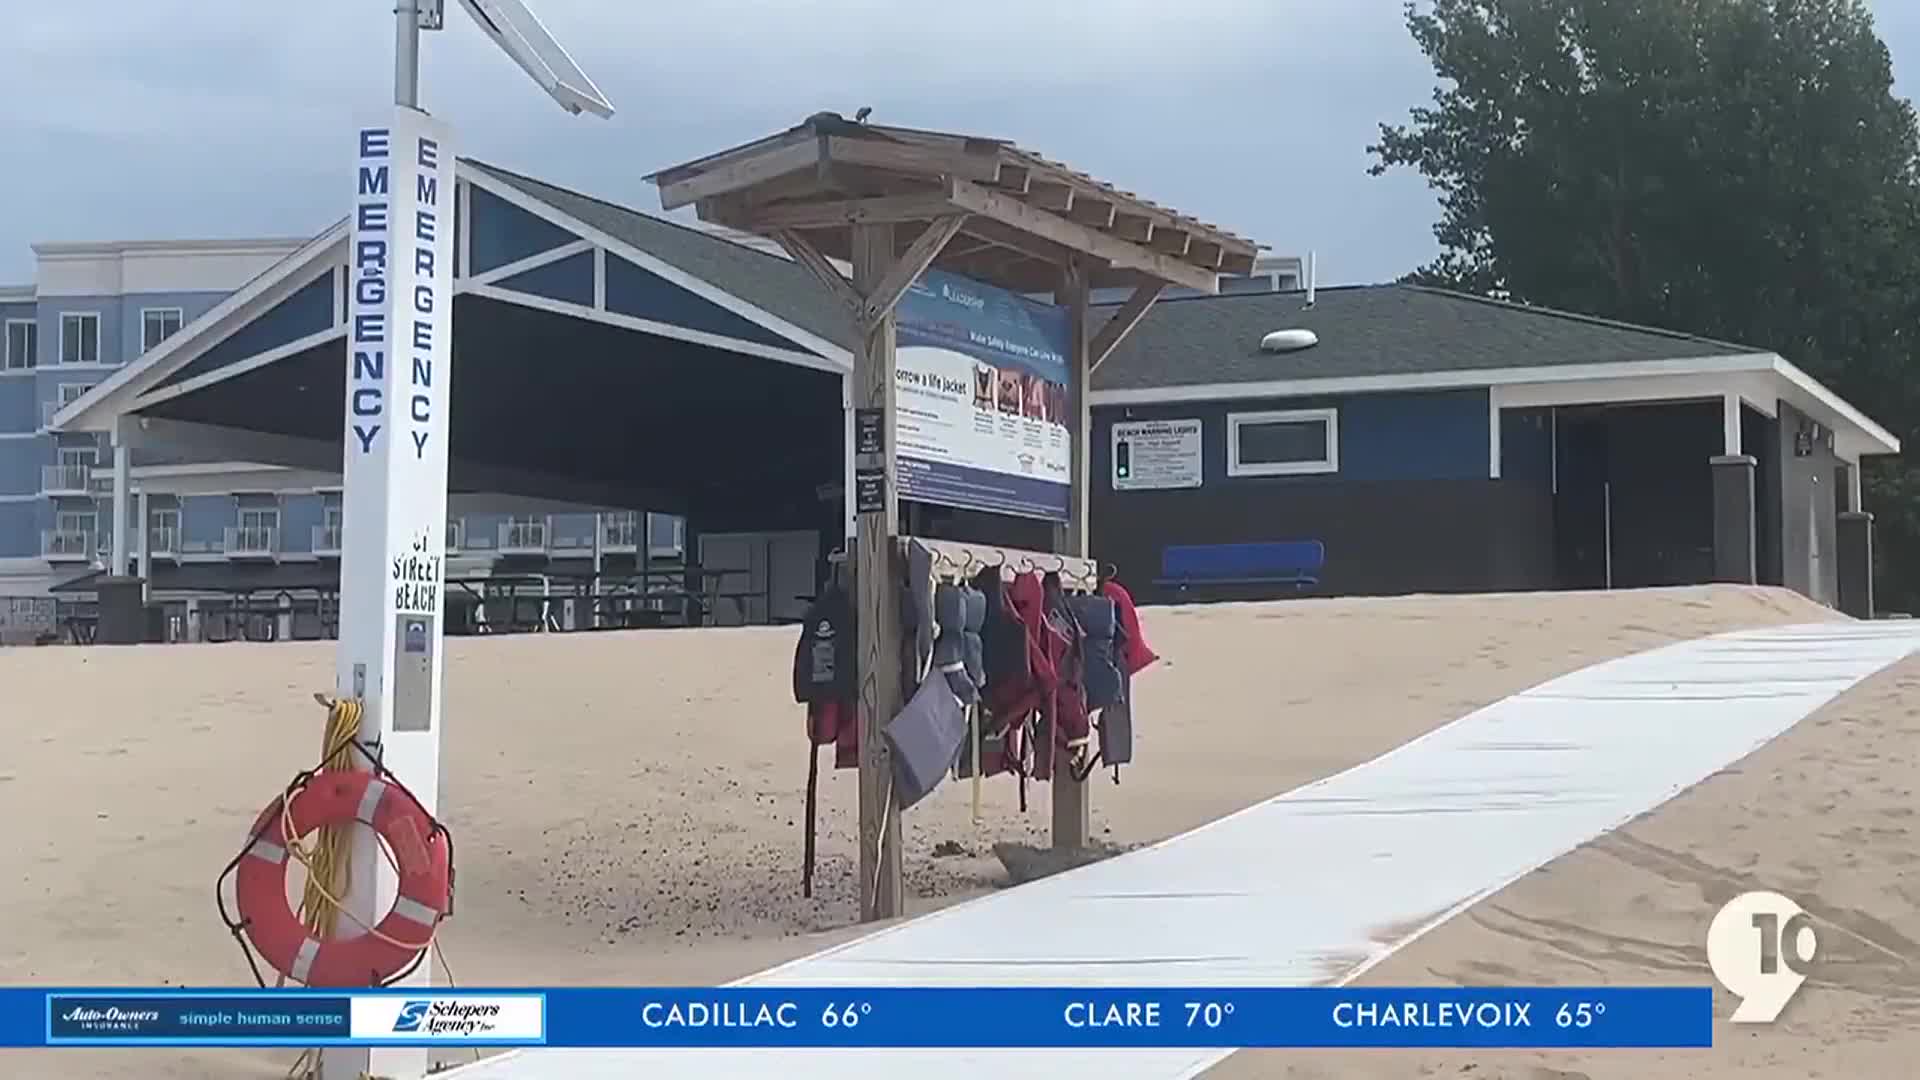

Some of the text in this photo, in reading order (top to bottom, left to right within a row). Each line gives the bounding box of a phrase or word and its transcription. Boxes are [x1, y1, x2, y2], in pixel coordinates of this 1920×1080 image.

[352, 129, 389, 454] EMERGENCY
[411, 137, 438, 459] EMERGENCY
[922, 375, 927, 386] a
[929, 373, 941, 389] life
[943, 376, 967, 395] jacket
[393, 555, 440, 582] STREET
[396, 583, 436, 612] BEACH
